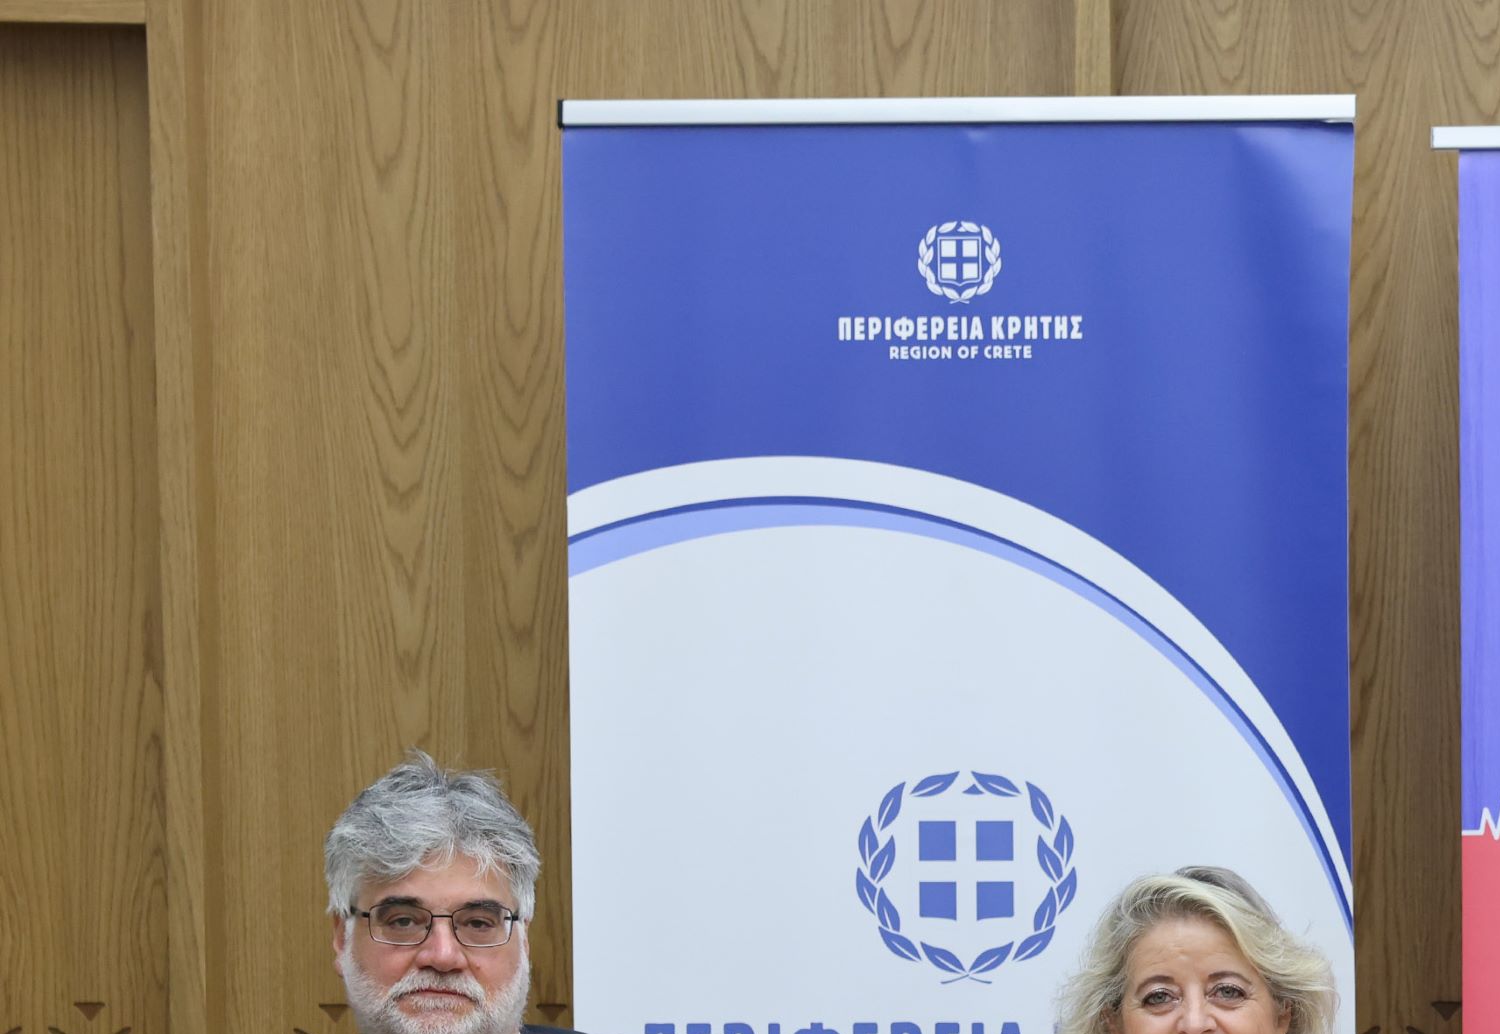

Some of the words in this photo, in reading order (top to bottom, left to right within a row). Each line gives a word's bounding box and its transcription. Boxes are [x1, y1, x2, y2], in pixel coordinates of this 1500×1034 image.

[838, 315, 984, 341] ΠΕΡΙΦΕΡΕΙΑ
[991, 315, 1083, 341] ΚΡΗΤΗΣ
[889, 345, 951, 360] REGION
[957, 345, 979, 359] OF
[984, 345, 1032, 359] CRETE
